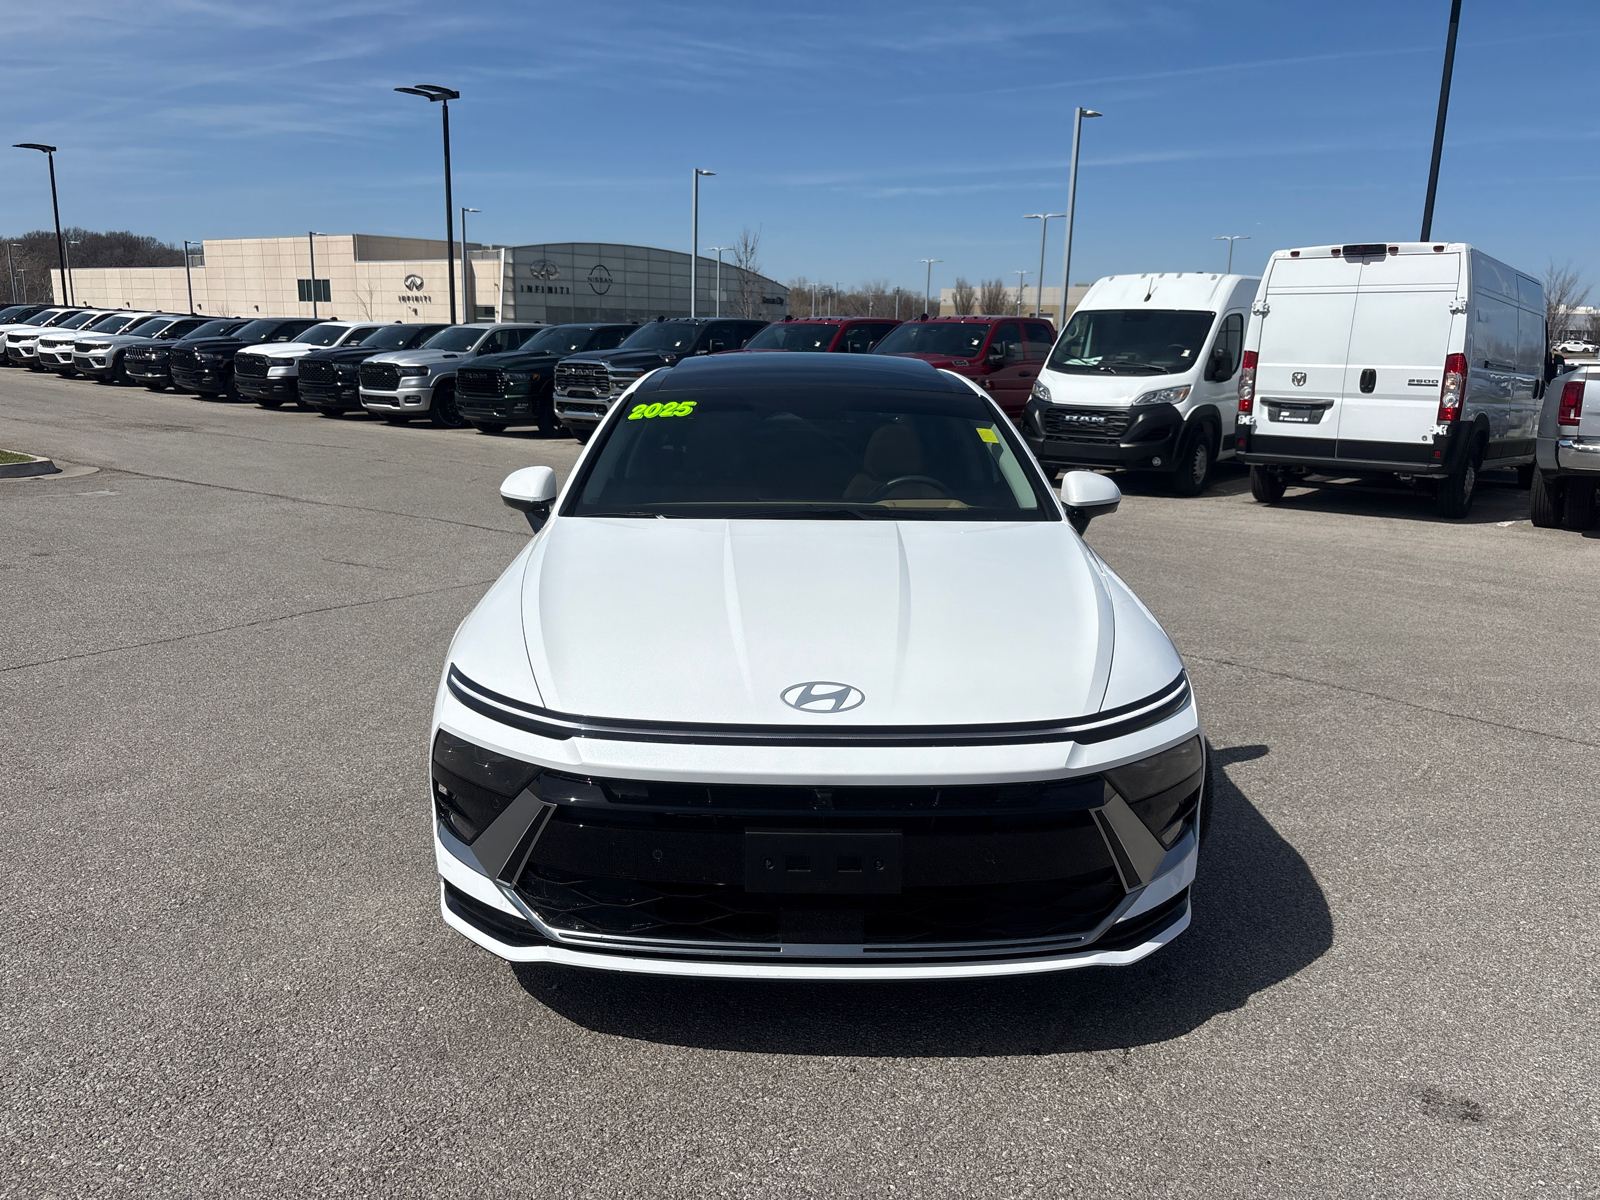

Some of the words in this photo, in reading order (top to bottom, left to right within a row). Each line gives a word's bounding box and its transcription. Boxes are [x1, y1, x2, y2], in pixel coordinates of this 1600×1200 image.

[587, 276, 613, 284] NISSAN
[520, 284, 570, 295] INFINITI
[628, 401, 697, 420] 2025
[1064, 415, 1105, 423] RAM
